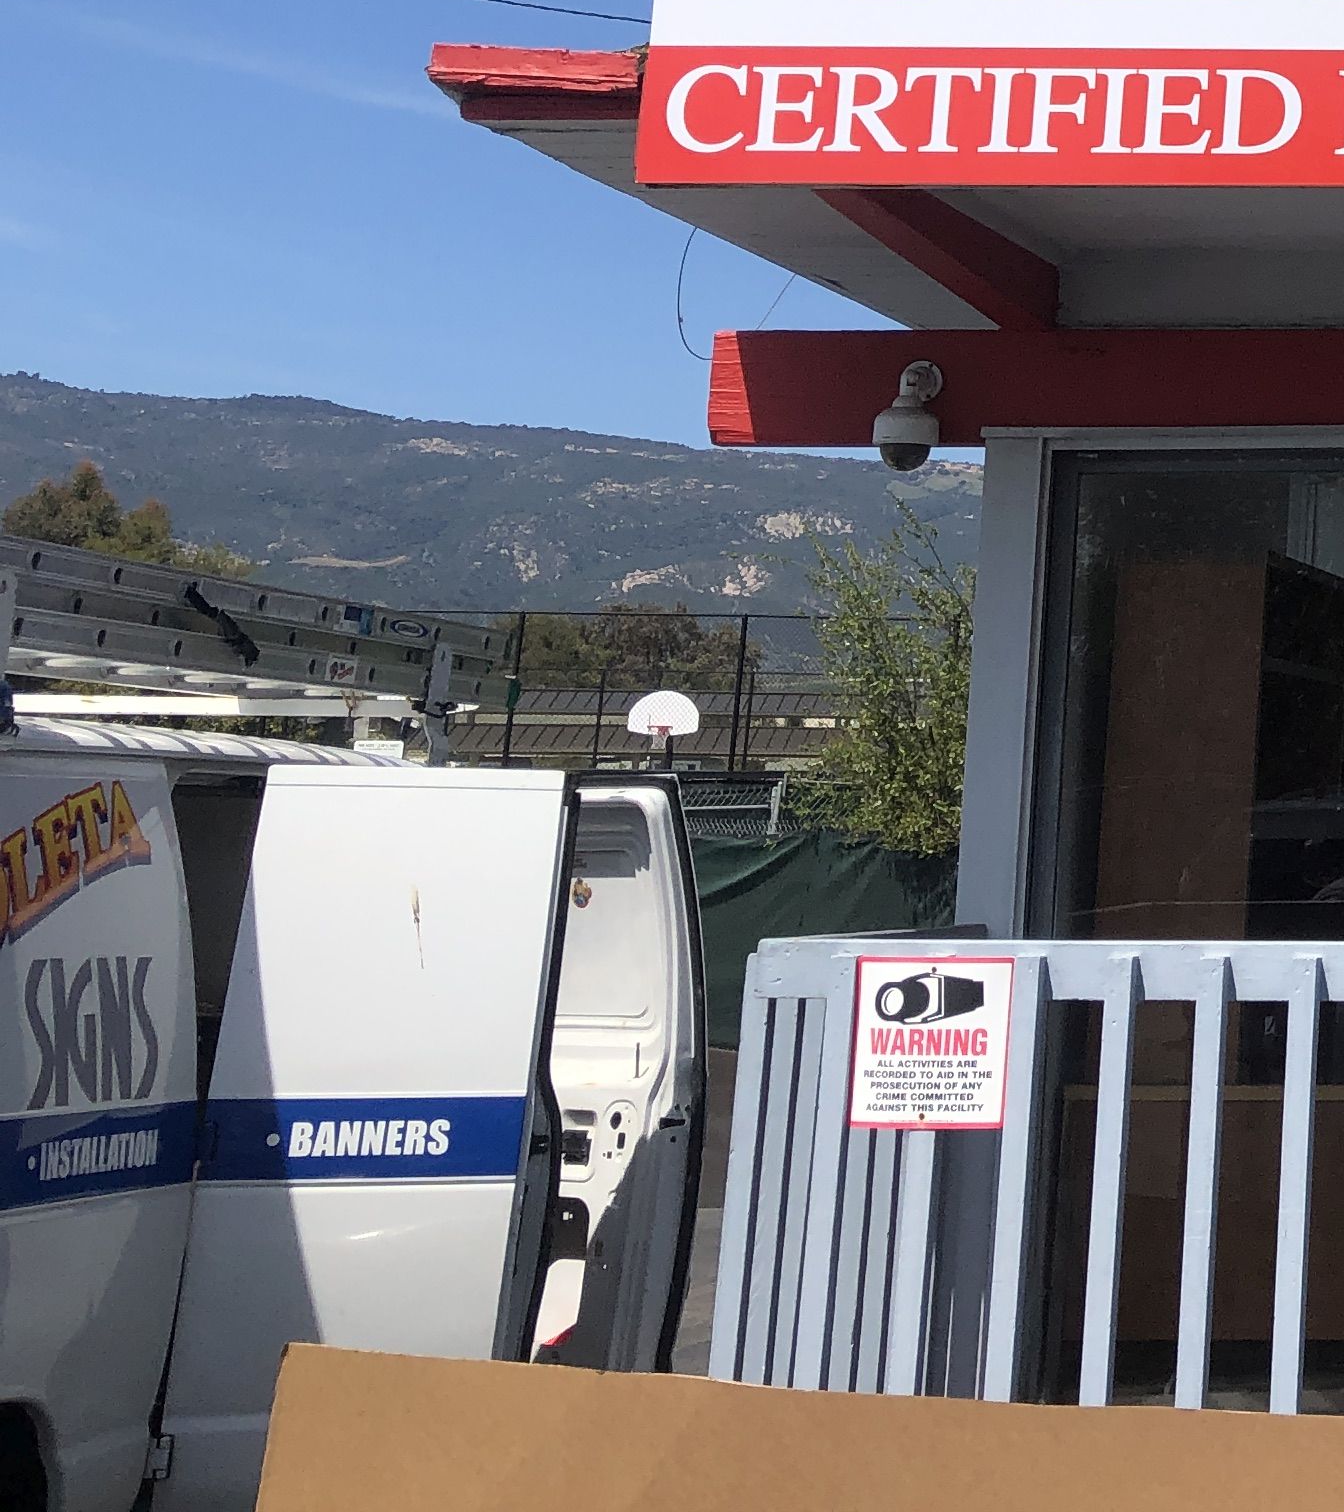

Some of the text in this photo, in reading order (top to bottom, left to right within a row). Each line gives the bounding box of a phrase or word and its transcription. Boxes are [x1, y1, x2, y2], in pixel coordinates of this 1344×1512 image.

[665, 64, 1303, 157] CERTIFIED
[0, 779, 151, 947] LETA
[25, 956, 159, 1110] SIGNS
[870, 1027, 988, 1057] WARNING
[863, 1070, 993, 1079] RECORDED TO AID IN THE
[877, 1059, 978, 1068] ALL ACTIVITIES ARE
[870, 1081, 983, 1090] PROSECUTION OF ANY
[875, 1092, 974, 1101] CRIME COMMITTED
[866, 1103, 984, 1112] AGAINST THIS FACILITY
[288, 1118, 451, 1157] BANNERS
[39, 1128, 159, 1181] INSTALLATION
